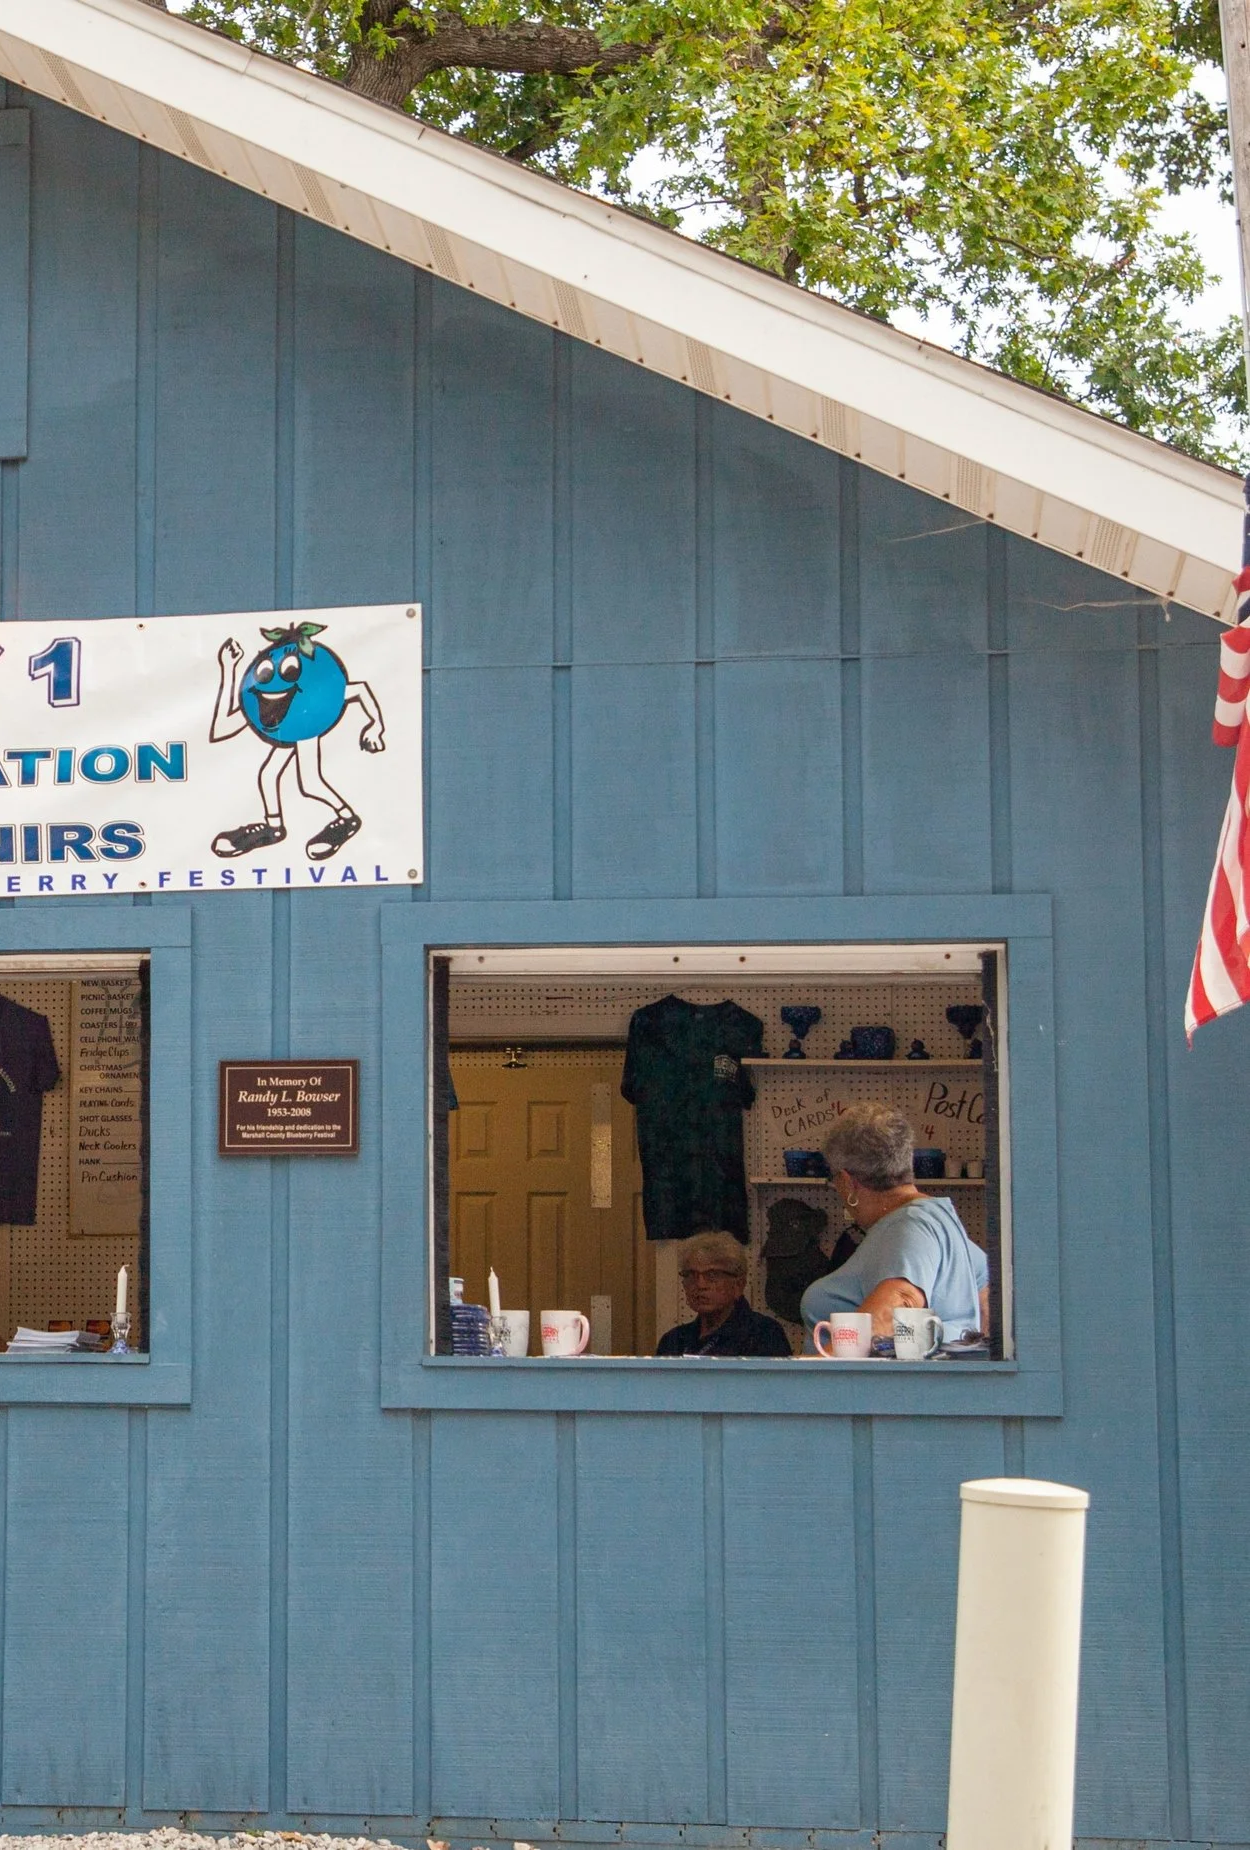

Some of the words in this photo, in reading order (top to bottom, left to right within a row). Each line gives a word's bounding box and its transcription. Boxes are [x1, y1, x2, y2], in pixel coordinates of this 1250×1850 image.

[28, 637, 81, 709] 1
[159, 865, 389, 887] FESTIVAL
[80, 1047, 107, 1058] Fridge
[108, 1047, 129, 1058] Clips
[257, 1077, 267, 1086] In
[269, 1078, 307, 1088] Memory
[309, 1076, 322, 1086] Of
[237, 1091, 278, 1106] Randy
[280, 1091, 292, 1102] L.
[296, 1091, 341, 1103] Bowser
[771, 1100, 806, 1119] Deck
[816, 1088, 830, 1103] of
[266, 1108, 311, 1117] 1953-2008
[256, 1124, 283, 1132] friendship
[784, 1109, 834, 1137] CARDS
[79, 1126, 110, 1137] Ducks
[266, 1131, 285, 1140] County
[286, 1131, 313, 1139] Blueberry
[79, 1141, 100, 1150] Neck
[104, 1140, 136, 1150] Coolers
[82, 1171, 98, 1182] Pin
[99, 1171, 137, 1182] Cushion
